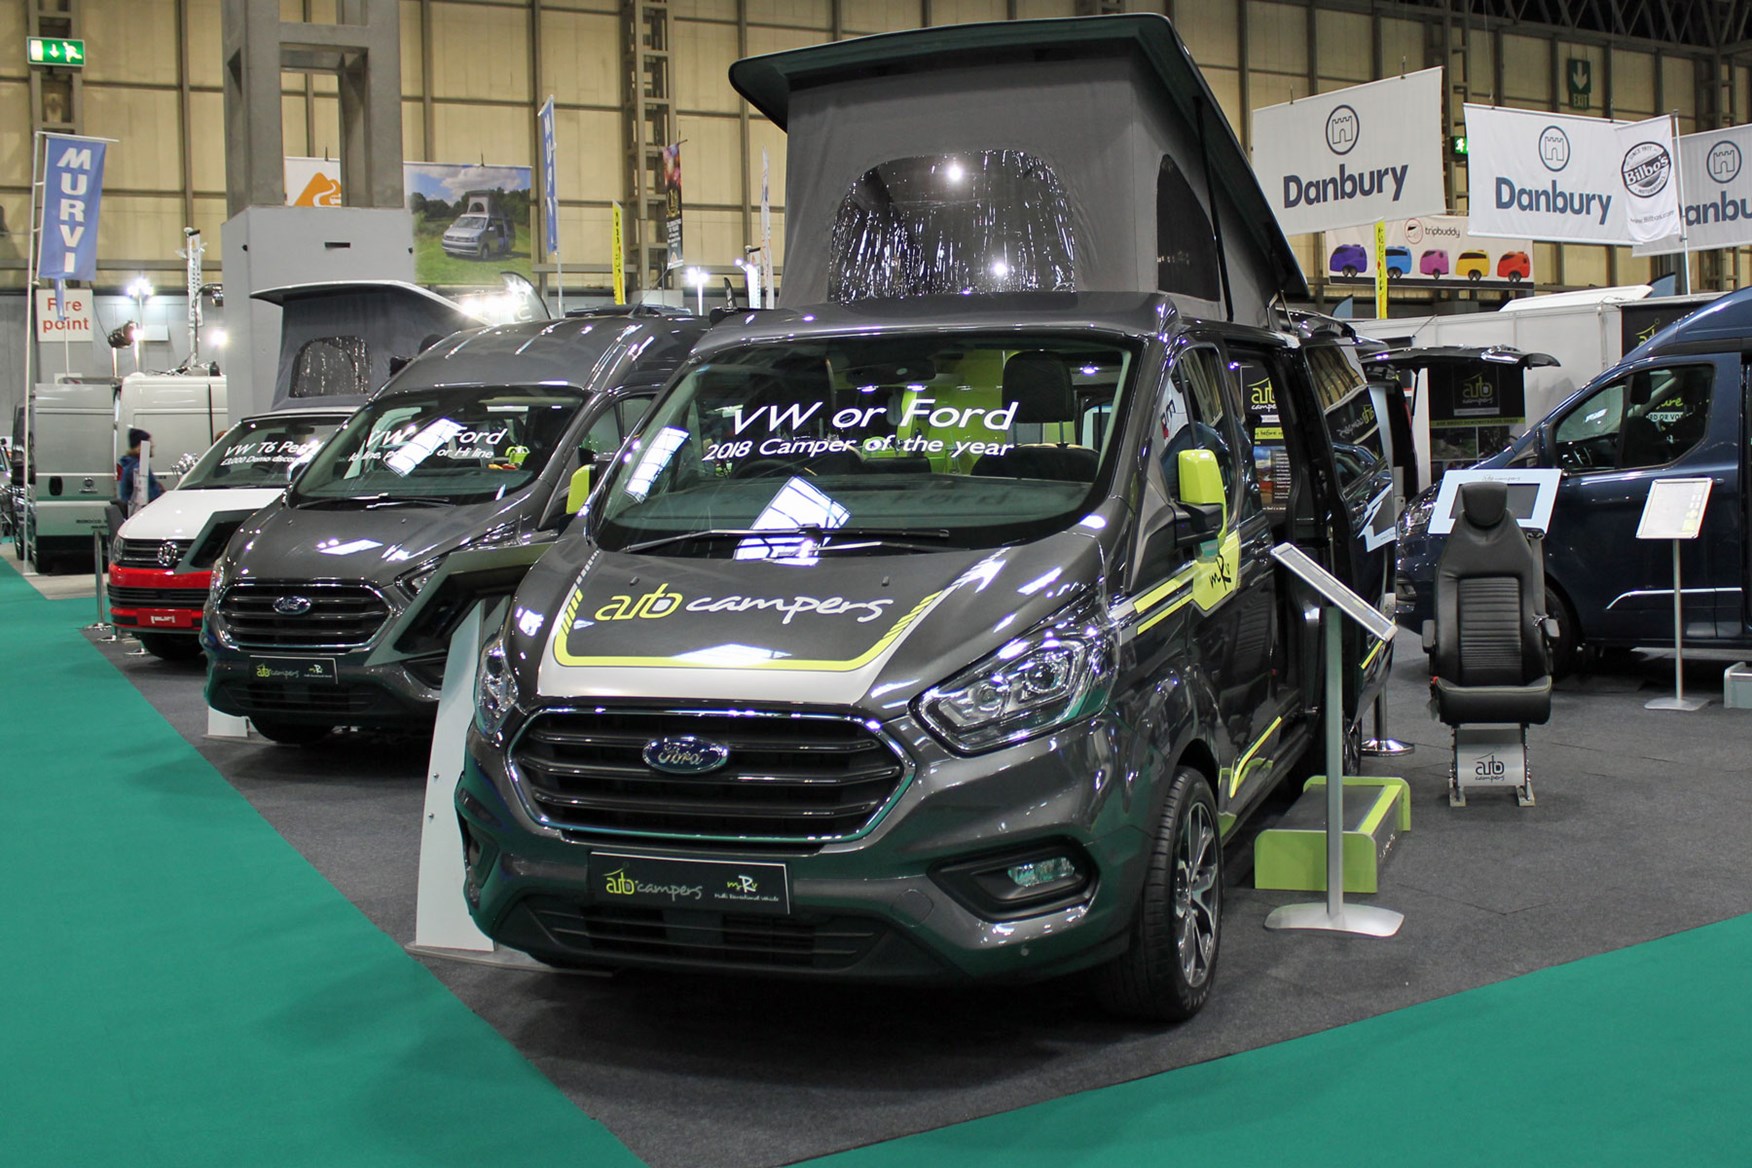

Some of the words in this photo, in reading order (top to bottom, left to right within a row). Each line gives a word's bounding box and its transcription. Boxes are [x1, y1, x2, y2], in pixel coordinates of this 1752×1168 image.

[1623, 154, 1669, 186] Bilbo's
[1283, 163, 1408, 209] Danbury
[56, 147, 92, 273] MURVI
[1495, 176, 1612, 226] Danbury
[1678, 190, 1752, 227] anbu
[1424, 226, 1461, 239] tripbuddy
[47, 297, 82, 312] Fre
[42, 317, 89, 334] point
[731, 401, 823, 435] VW
[832, 407, 886, 429] or
[899, 399, 1019, 431] Ford
[224, 443, 257, 457] VW
[257, 441, 279, 454] T6
[702, 441, 752, 461] 2018
[760, 436, 857, 460] Camper
[865, 435, 895, 454] of
[900, 435, 943, 453] the
[953, 440, 1015, 459] year
[685, 594, 893, 625] campers
[657, 743, 705, 766] Ford
[635, 881, 703, 902] campers
